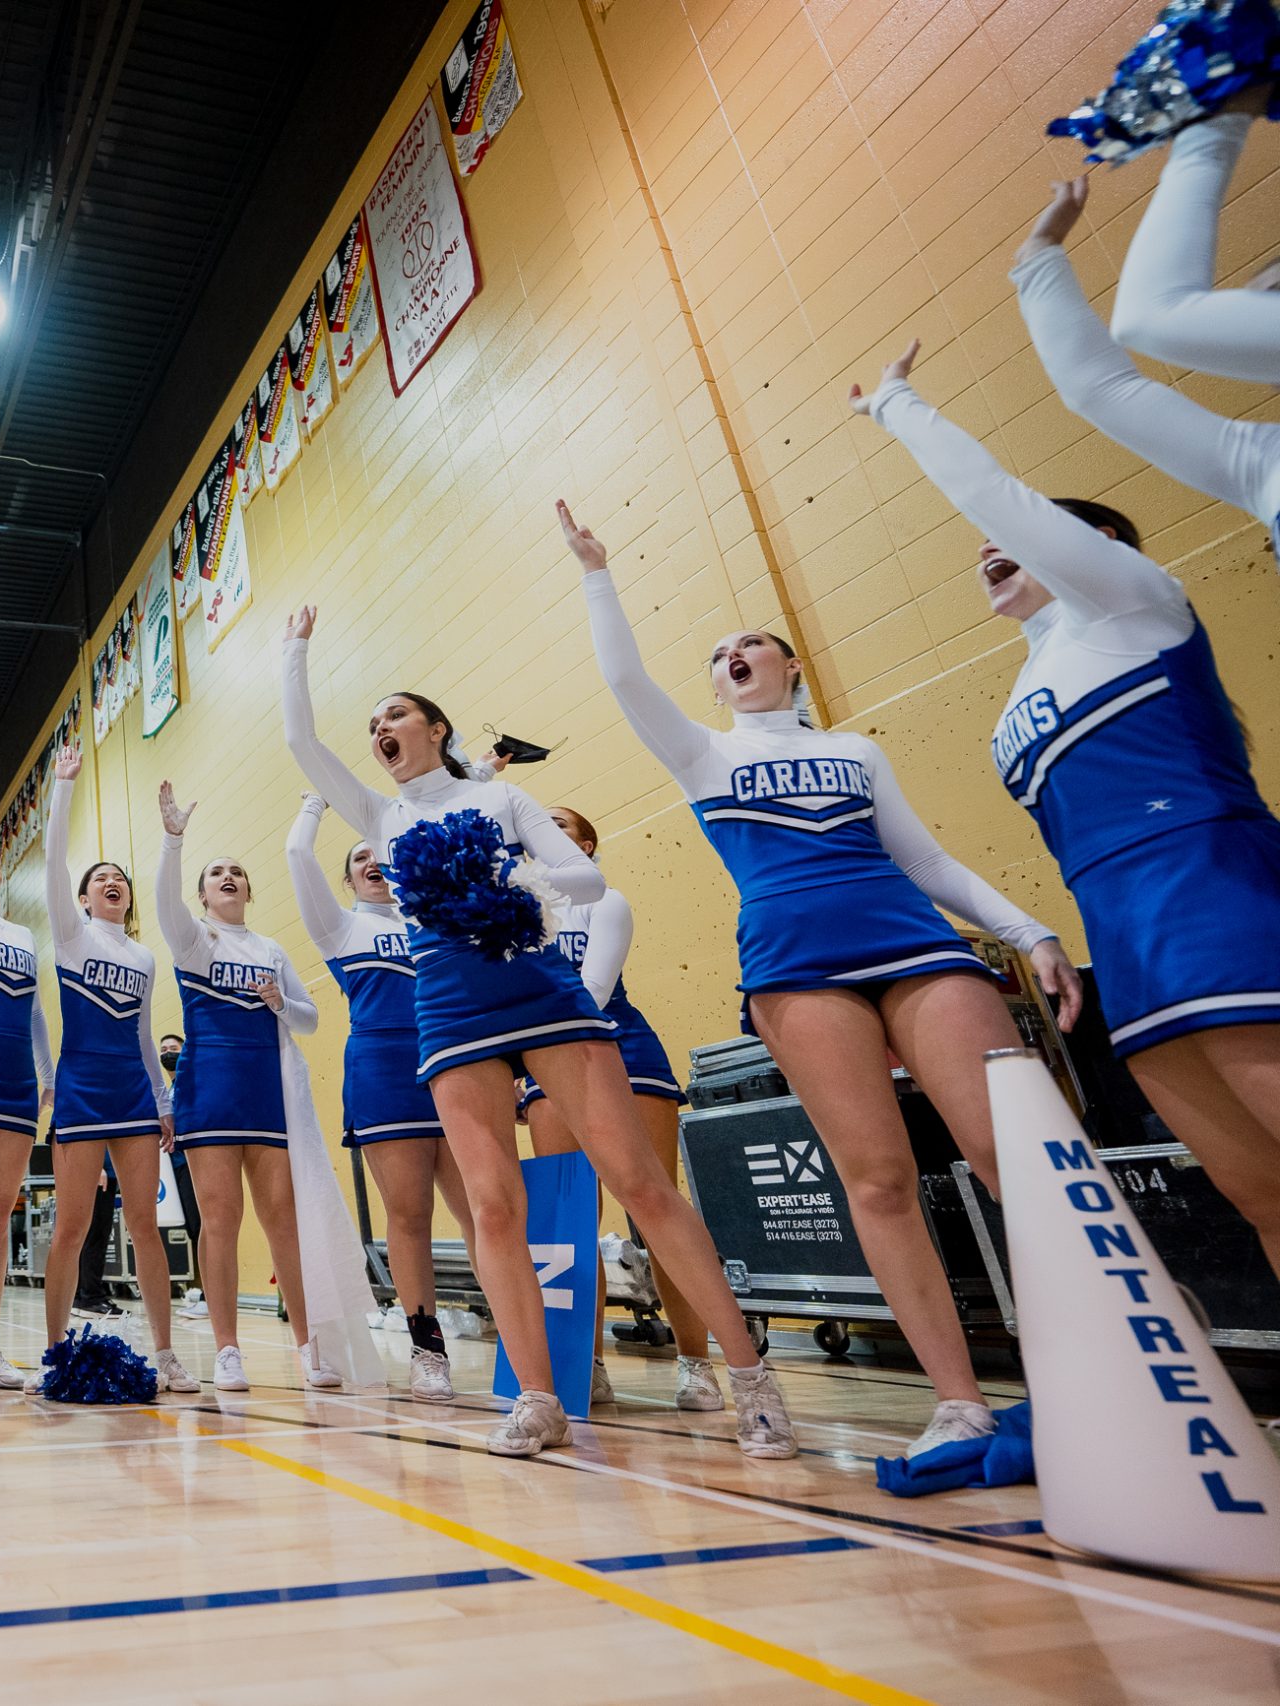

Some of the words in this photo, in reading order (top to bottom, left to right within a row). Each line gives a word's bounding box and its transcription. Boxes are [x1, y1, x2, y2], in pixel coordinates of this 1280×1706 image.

[464, 17, 499, 122] CHAMPIONS
[370, 106, 431, 211] BASKETBALL
[381, 138, 425, 212] FÉMININ
[399, 200, 427, 245] 1995
[336, 288, 350, 323] ESPRIT
[345, 242, 362, 285] SPORTIF
[395, 236, 460, 332] CHAMPIONNE
[201, 478, 225, 553] BASKET-BALL
[206, 475, 233, 570] CHAMPIONNE
[732, 760, 873, 804] CARABINS
[83, 959, 148, 999] CARABIN
[757, 1193, 833, 1208] EXPERT'EASE
[785, 1207, 814, 1215] ÉCLAIRAGE
[817, 1206, 835, 1214] VIDÉO
[813, 1218, 840, 1230] (3273)
[817, 1231, 843, 1242] (3273)
[1043, 1140, 1267, 1514] MONTREAL
